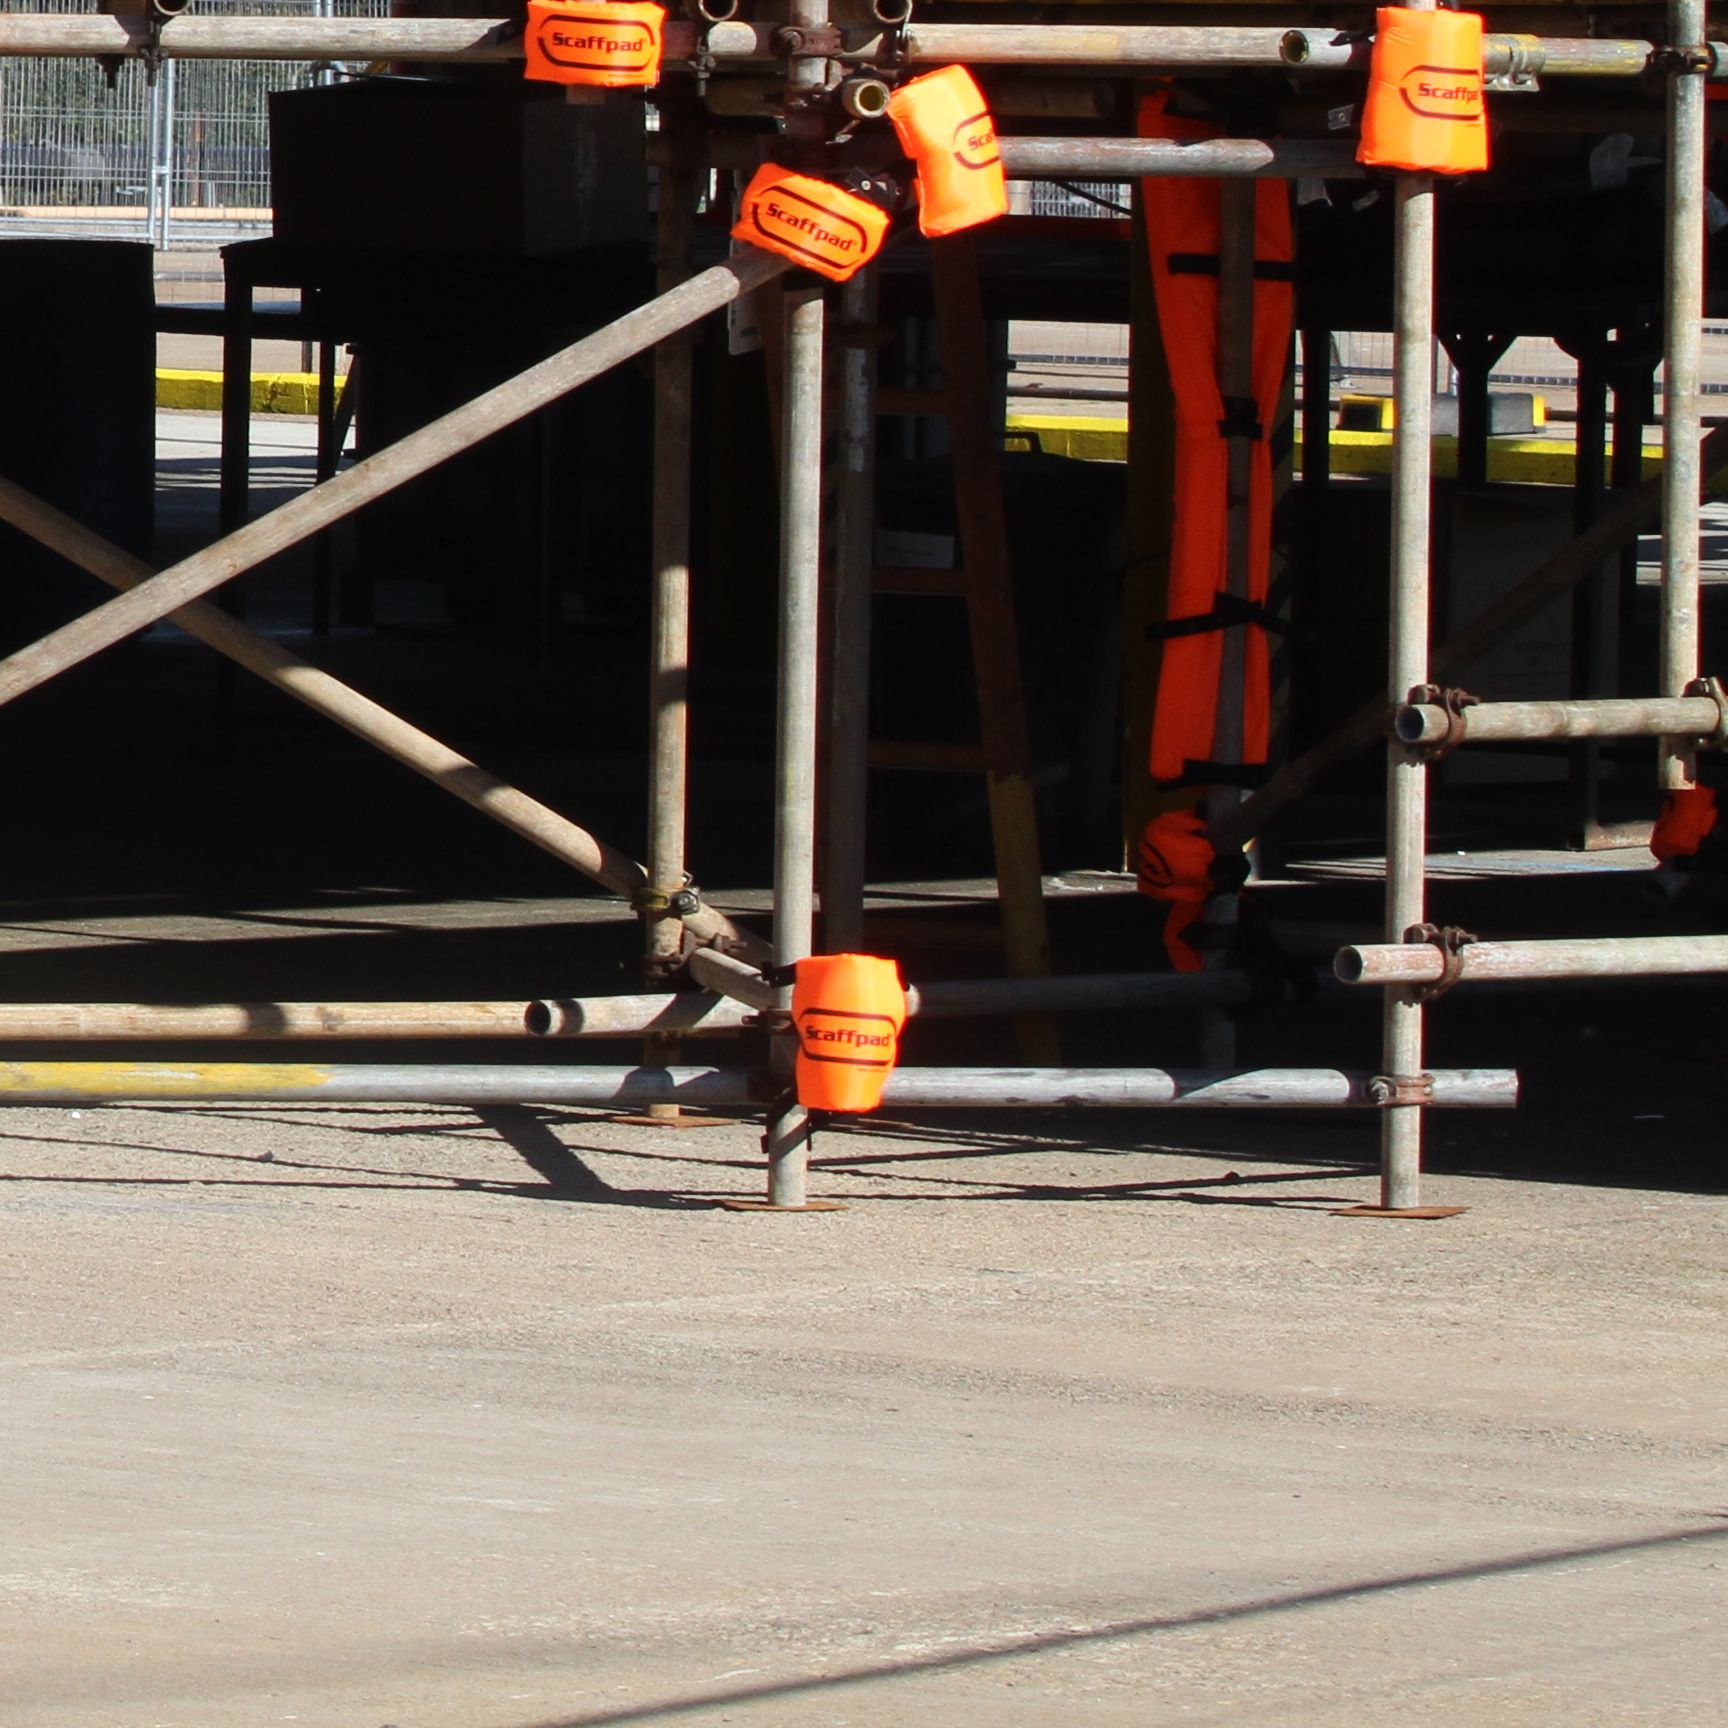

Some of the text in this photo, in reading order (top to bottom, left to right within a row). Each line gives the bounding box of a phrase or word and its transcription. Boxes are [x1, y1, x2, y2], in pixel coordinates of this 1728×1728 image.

[552, 31, 643, 54] Scaffpad
[765, 200, 853, 252] Scaffpad
[805, 1024, 890, 1048] Scaffpad
